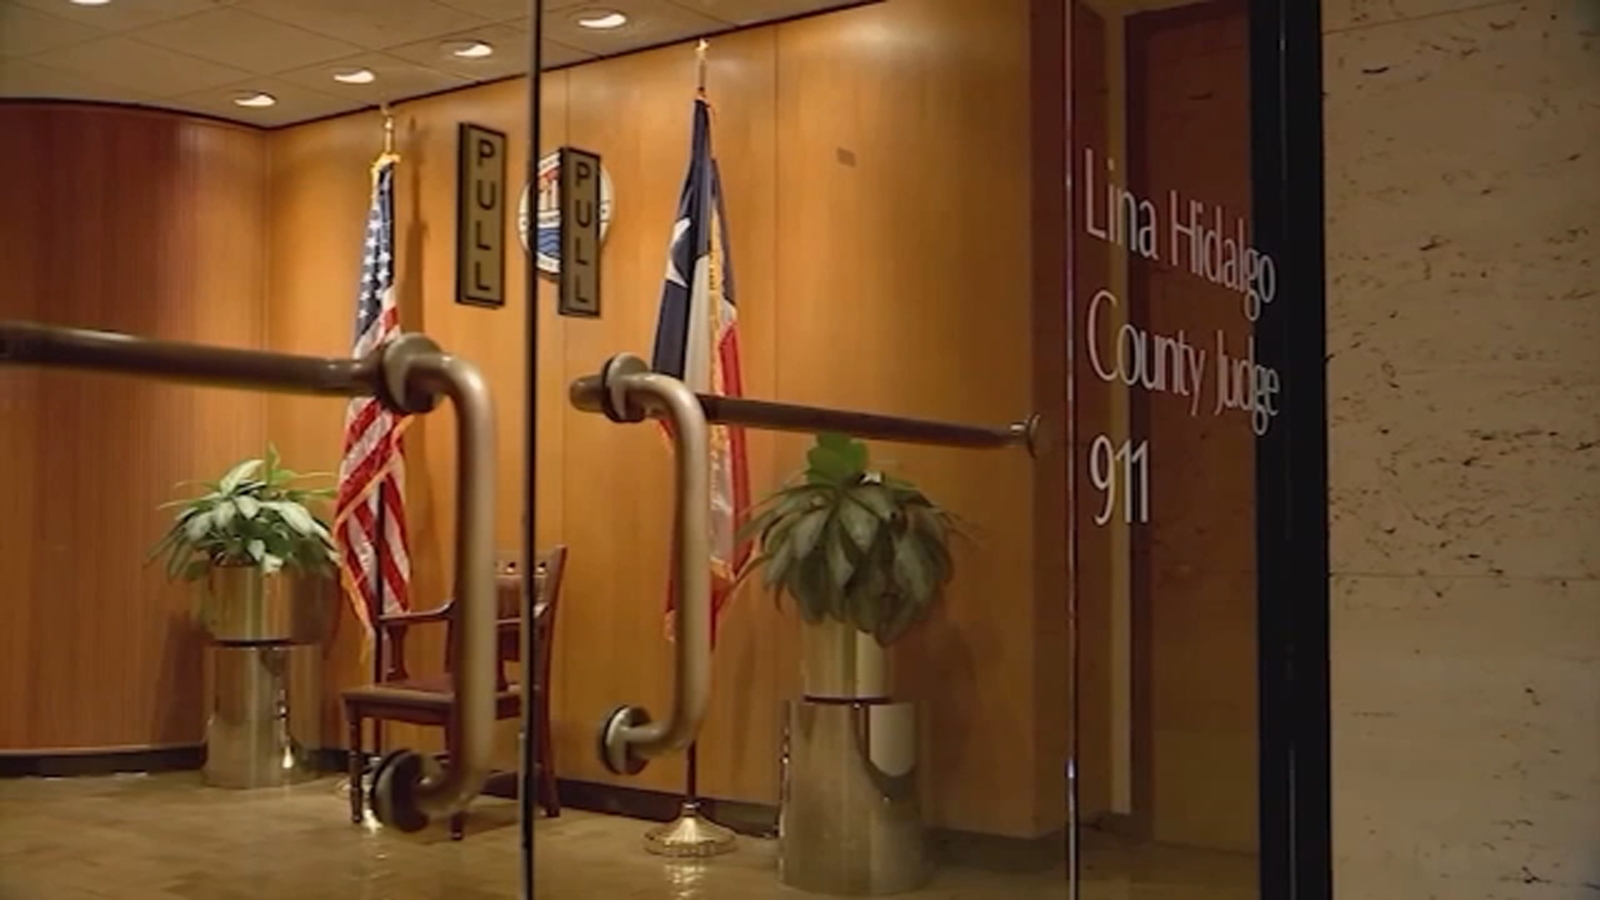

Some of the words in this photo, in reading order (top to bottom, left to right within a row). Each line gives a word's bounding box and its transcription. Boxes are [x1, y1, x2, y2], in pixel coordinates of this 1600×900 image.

[475, 139, 496, 291] PULL
[575, 161, 592, 303] PULL
[1085, 148, 1158, 260] Lina
[1171, 190, 1275, 321] Hidalgo
[1088, 289, 1206, 416] County
[1215, 329, 1280, 435] Judge
[1090, 434, 1148, 525] 911
